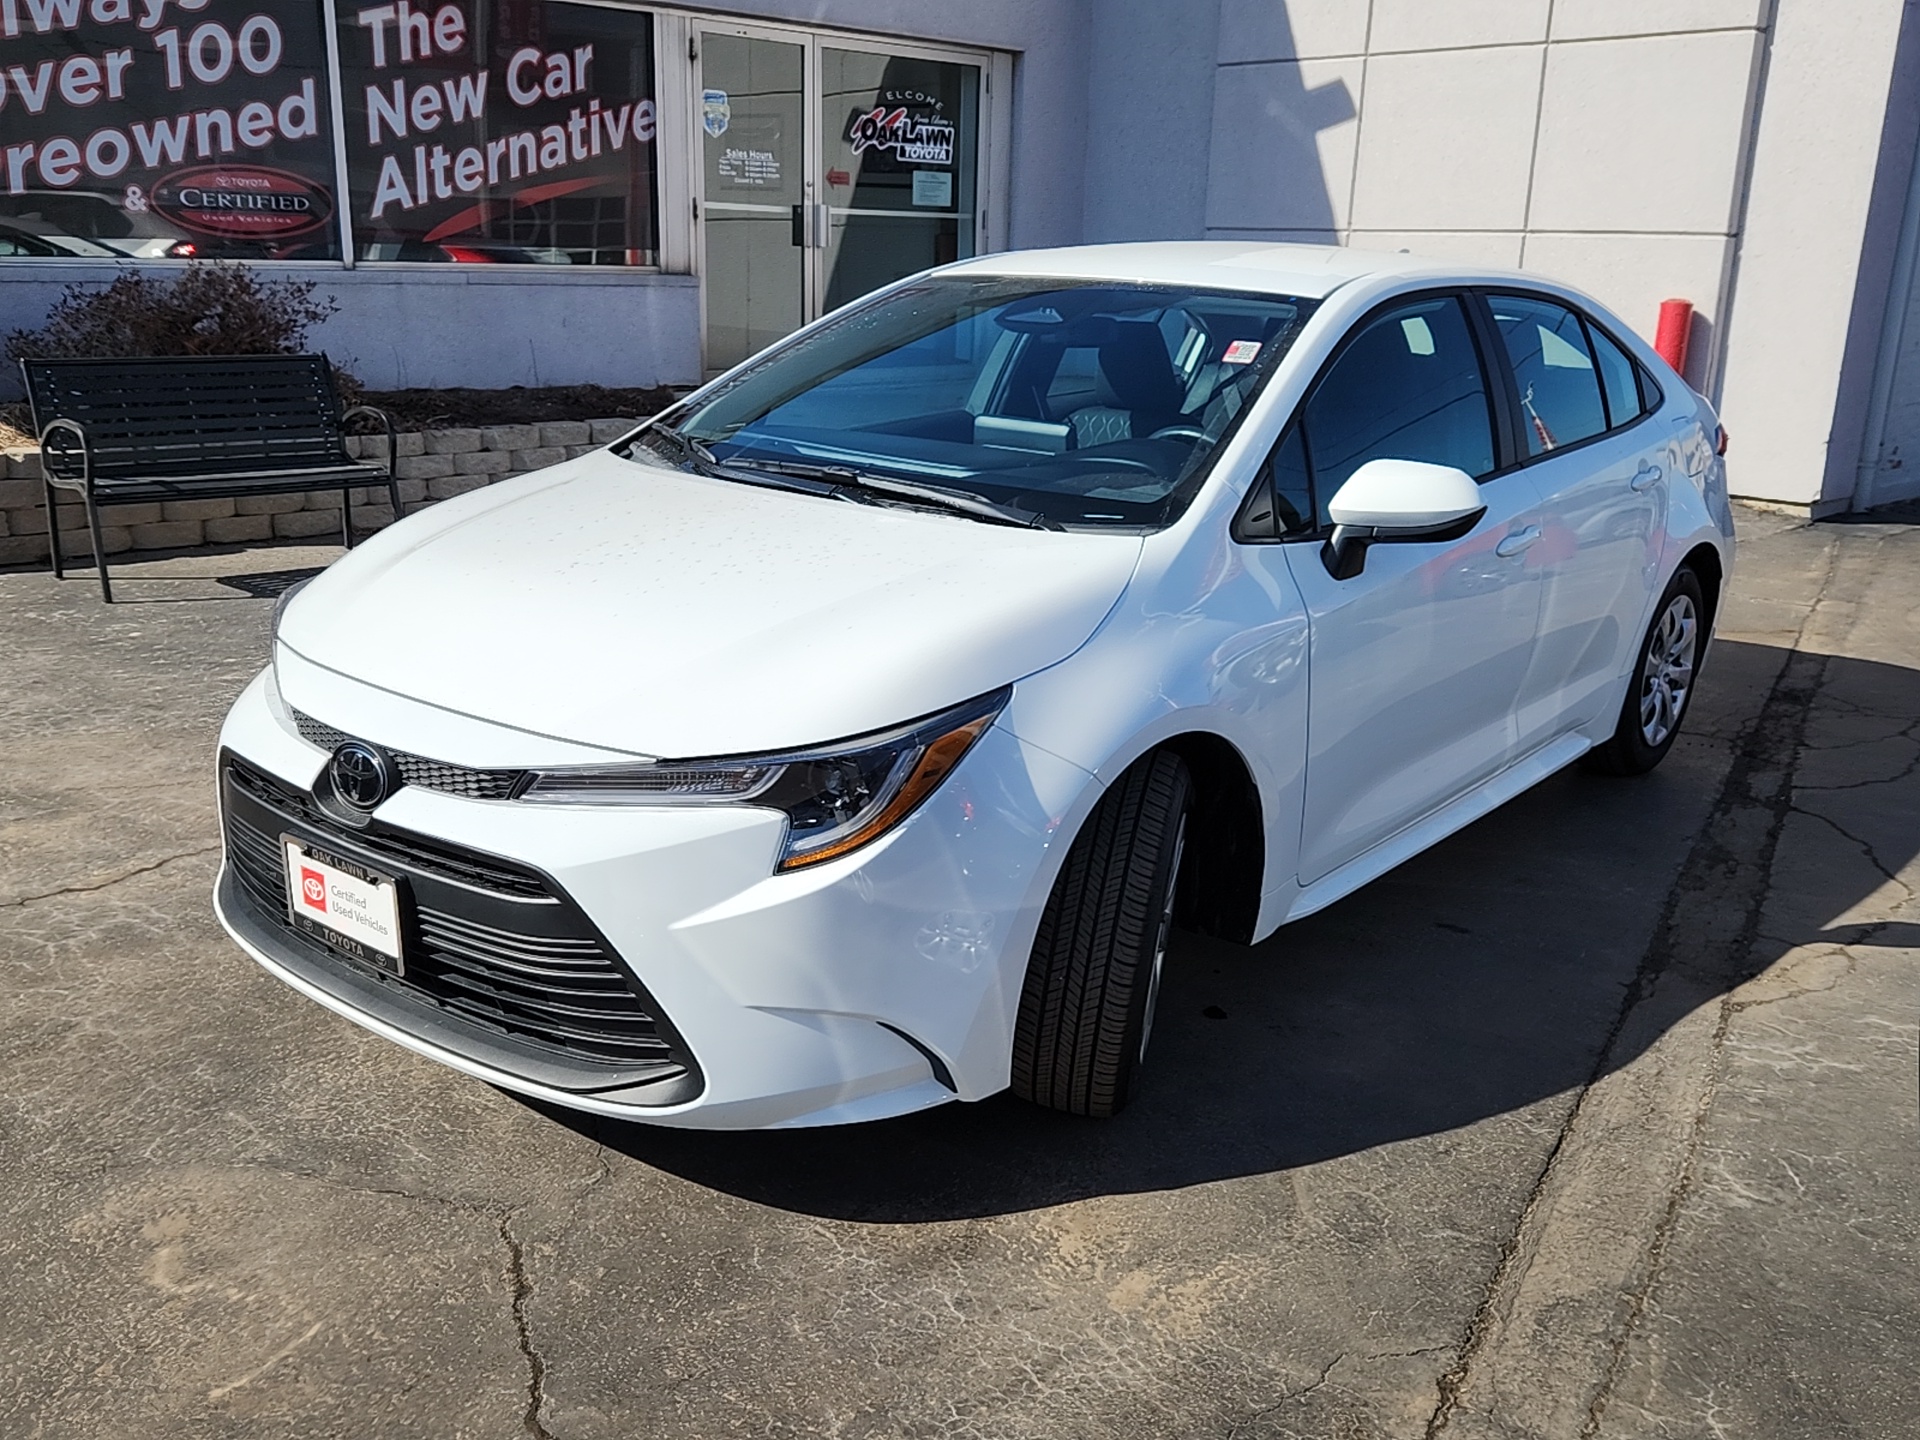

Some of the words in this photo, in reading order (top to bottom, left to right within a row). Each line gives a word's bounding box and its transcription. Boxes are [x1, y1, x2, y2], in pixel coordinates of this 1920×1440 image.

[3, 0, 209, 36] lwa
[358, 1, 466, 67] The
[0, 50, 133, 113] ver
[155, 15, 282, 89] 100
[365, 70, 489, 145] New
[506, 43, 594, 106] Car
[370, 99, 656, 219] Alternative
[725, 148, 748, 159] Sales
[904, 146, 947, 160] TOYOTA
[231, 177, 271, 188] TOYOTA
[124, 185, 149, 212] &
[311, 849, 333, 867] OAK
[334, 857, 365, 879] LAWN
[330, 885, 367, 909] Certified
[331, 900, 354, 919] Used
[353, 910, 389, 936] Vehicles
[322, 928, 365, 957] TOYOTA
